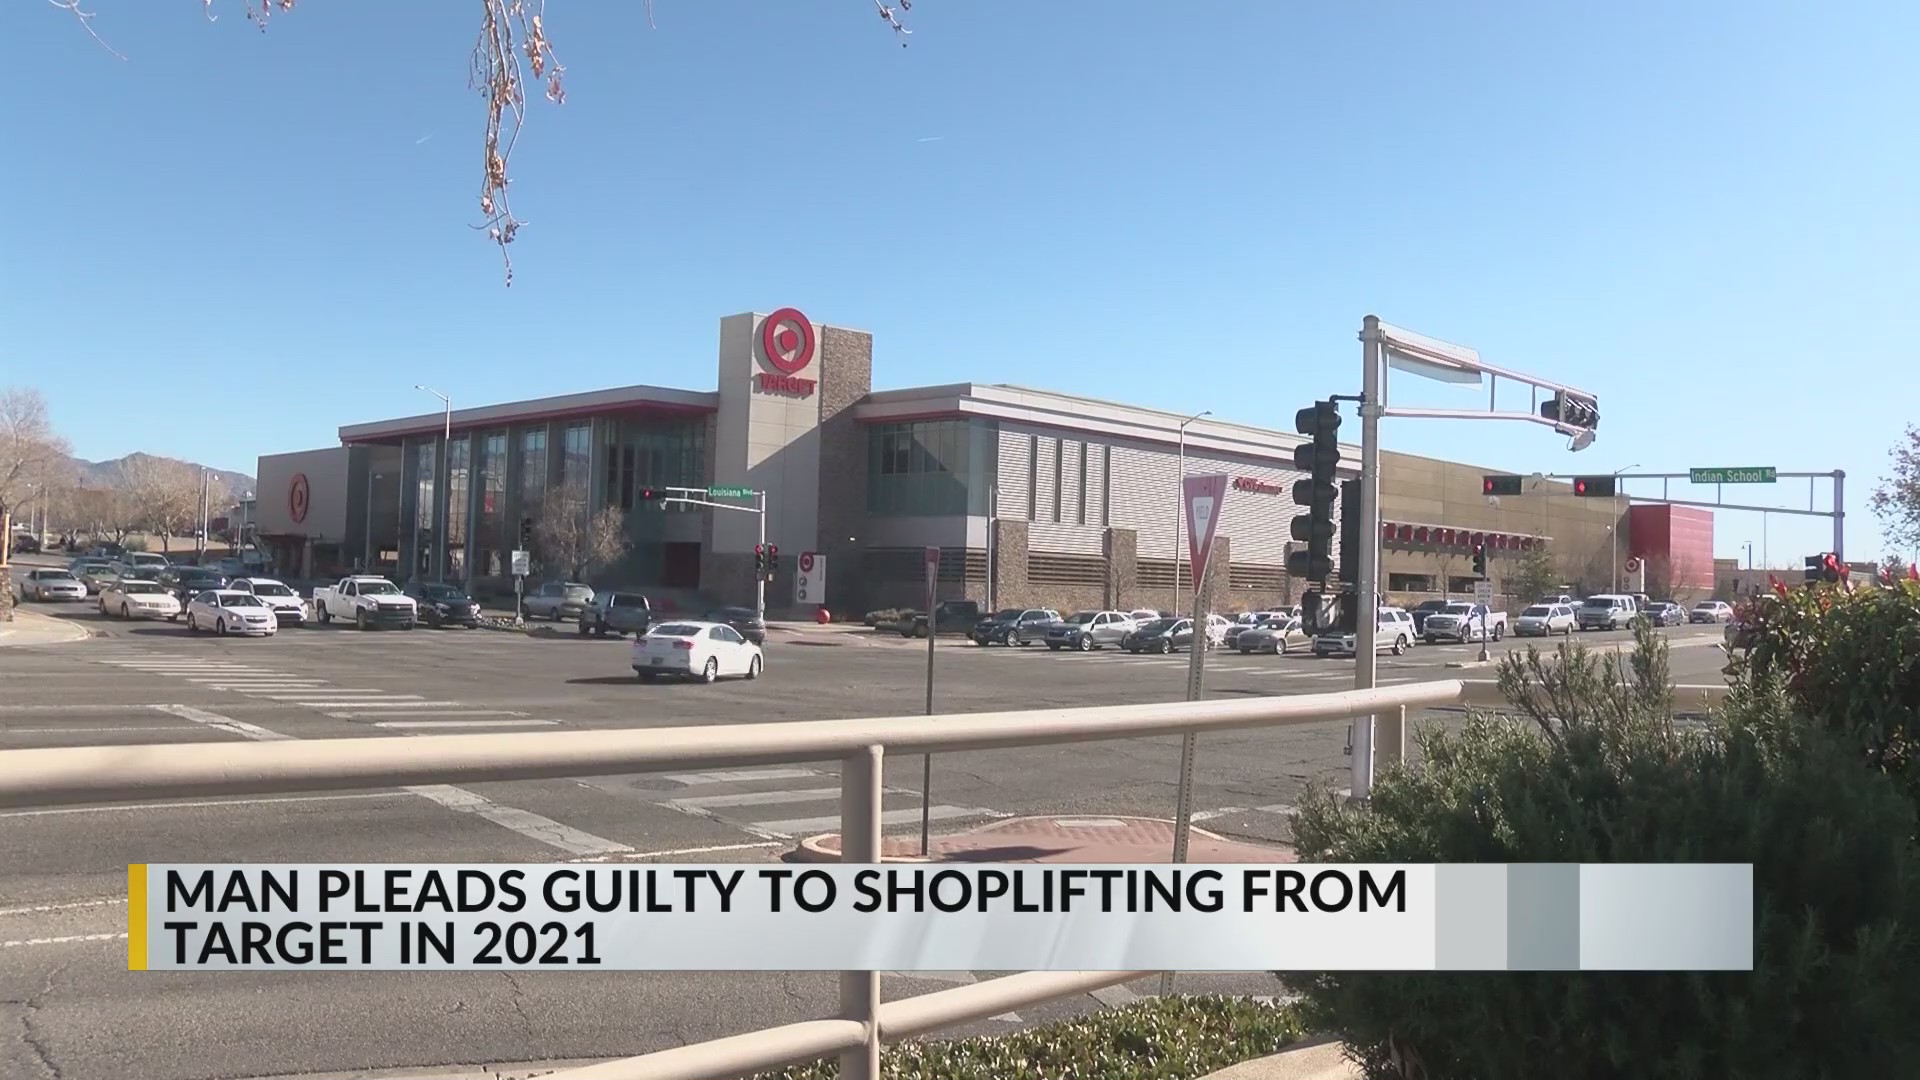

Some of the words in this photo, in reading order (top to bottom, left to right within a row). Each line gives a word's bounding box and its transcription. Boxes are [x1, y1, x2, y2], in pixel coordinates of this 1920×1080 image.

[759, 373, 817, 395] TARGET
[1692, 470, 1723, 482] Indian
[1727, 469, 1762, 482] School
[1765, 468, 1775, 478] Rd
[708, 487, 741, 497] Louisiana
